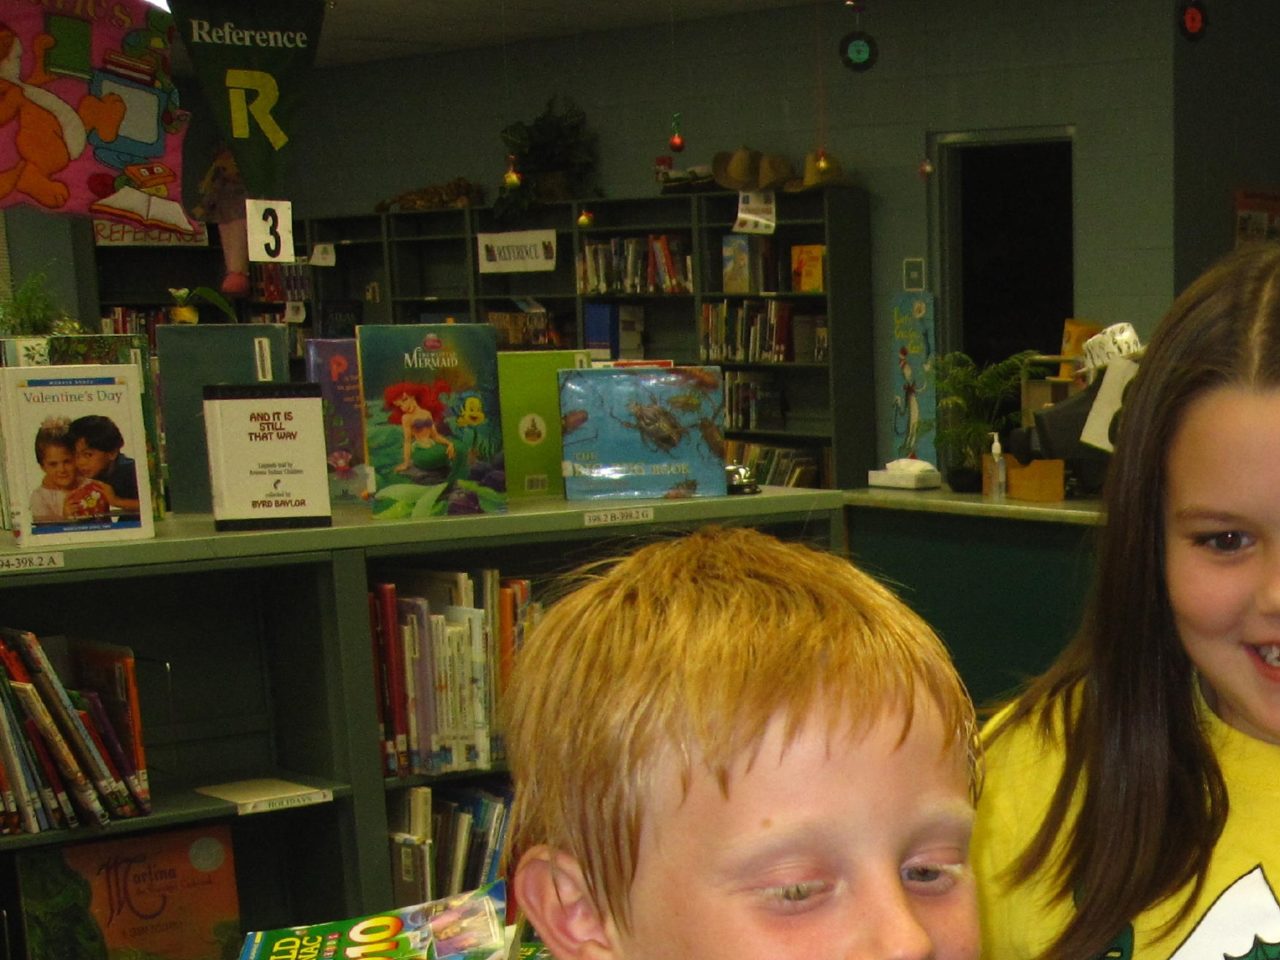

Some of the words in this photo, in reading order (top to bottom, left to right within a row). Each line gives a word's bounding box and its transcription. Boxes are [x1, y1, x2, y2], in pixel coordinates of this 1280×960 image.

[190, 18, 308, 48] Reference
[224, 68, 289, 151] R
[262, 207, 281, 258] 3
[24, 390, 94, 403] Valentine's
[97, 390, 123, 404] Day
[250, 412, 271, 422] AND
[273, 412, 281, 421] IT
[284, 411, 293, 420] IS
[260, 422, 285, 431] STILL
[249, 432, 273, 441] THAT
[277, 431, 298, 440] WAY
[252, 500, 272, 508] BYRD
[275, 499, 306, 508] BAYLOR
[47, 556, 56, 566] A
